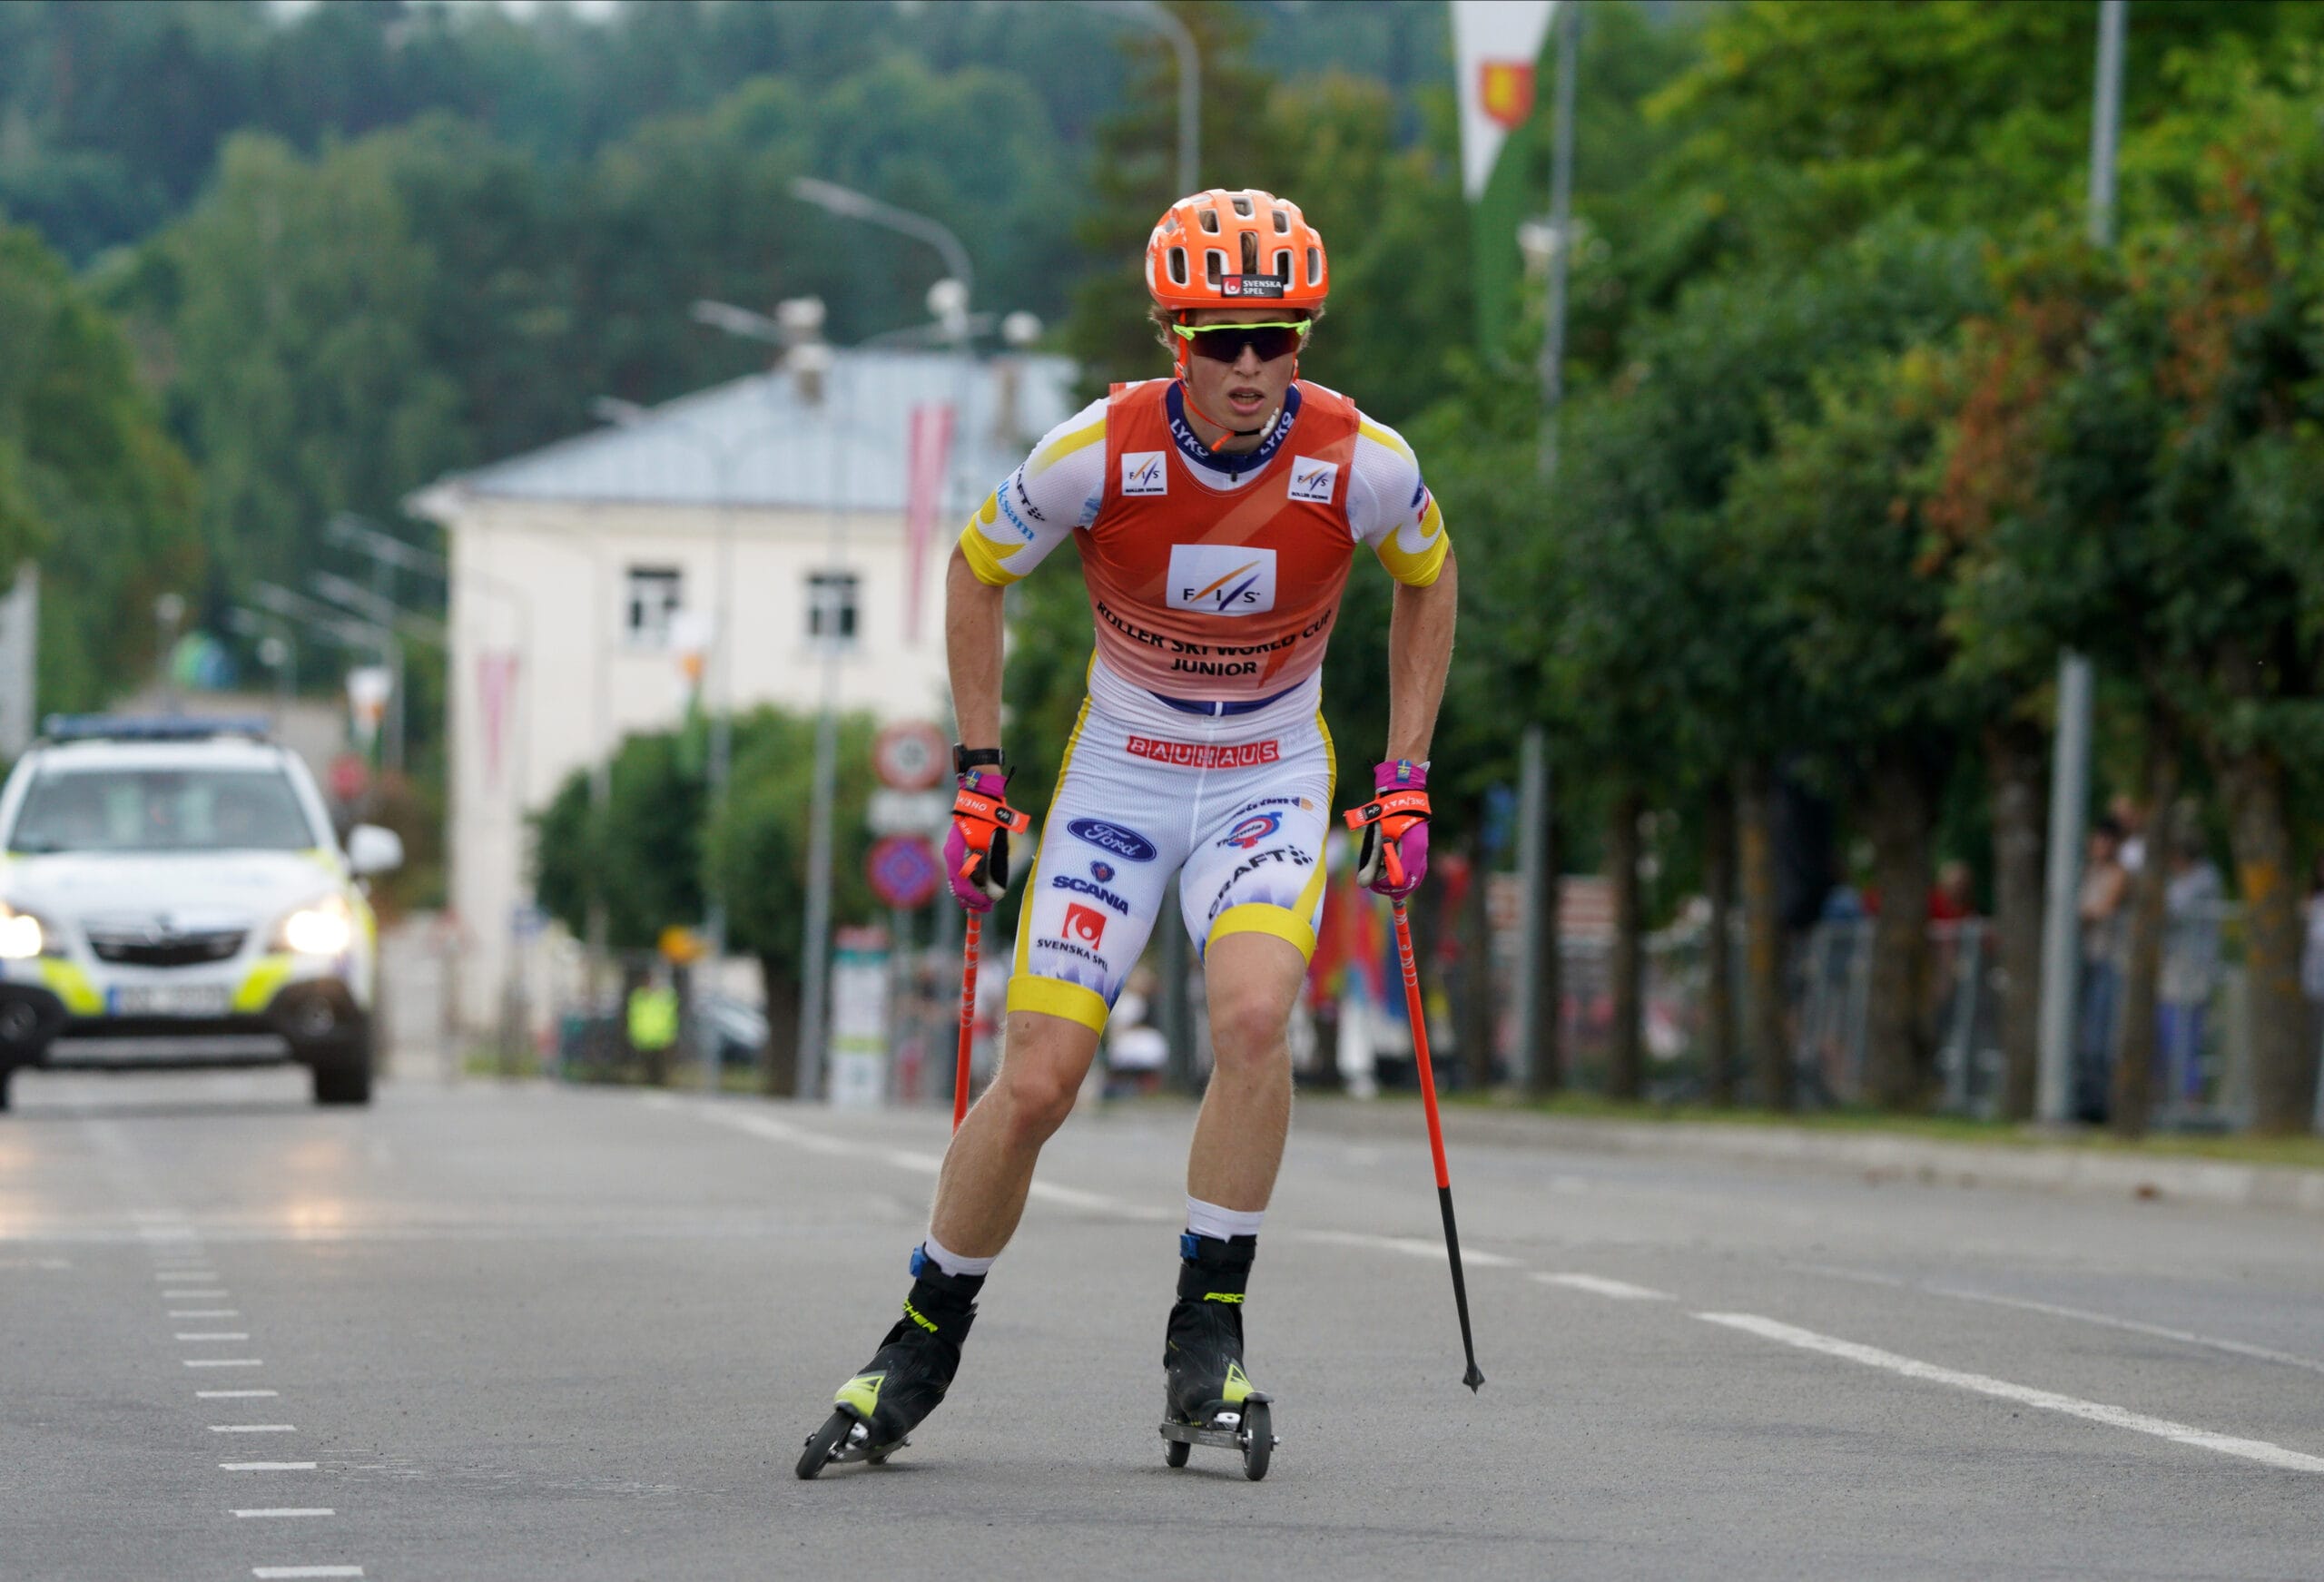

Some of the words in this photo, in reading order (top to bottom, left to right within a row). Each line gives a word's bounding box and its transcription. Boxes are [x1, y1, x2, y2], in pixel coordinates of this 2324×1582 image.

[1243, 280, 1282, 288] SVENSKA
[1243, 287, 1265, 295] SPEL
[1097, 603, 1163, 648] ROLLER
[1171, 638, 1209, 655] SKI
[1217, 634, 1294, 656] WORLD
[1302, 609, 1332, 639] CUP
[1171, 658, 1256, 676] JUNIOR
[1129, 738, 1276, 766] BAUHAUS
[1085, 824, 1141, 856] Ford
[1052, 876, 1128, 916] SCANIA
[1208, 849, 1286, 920] CRAFT
[1037, 938, 1089, 960] SVENSKA
[1204, 1292, 1245, 1303] FISC
